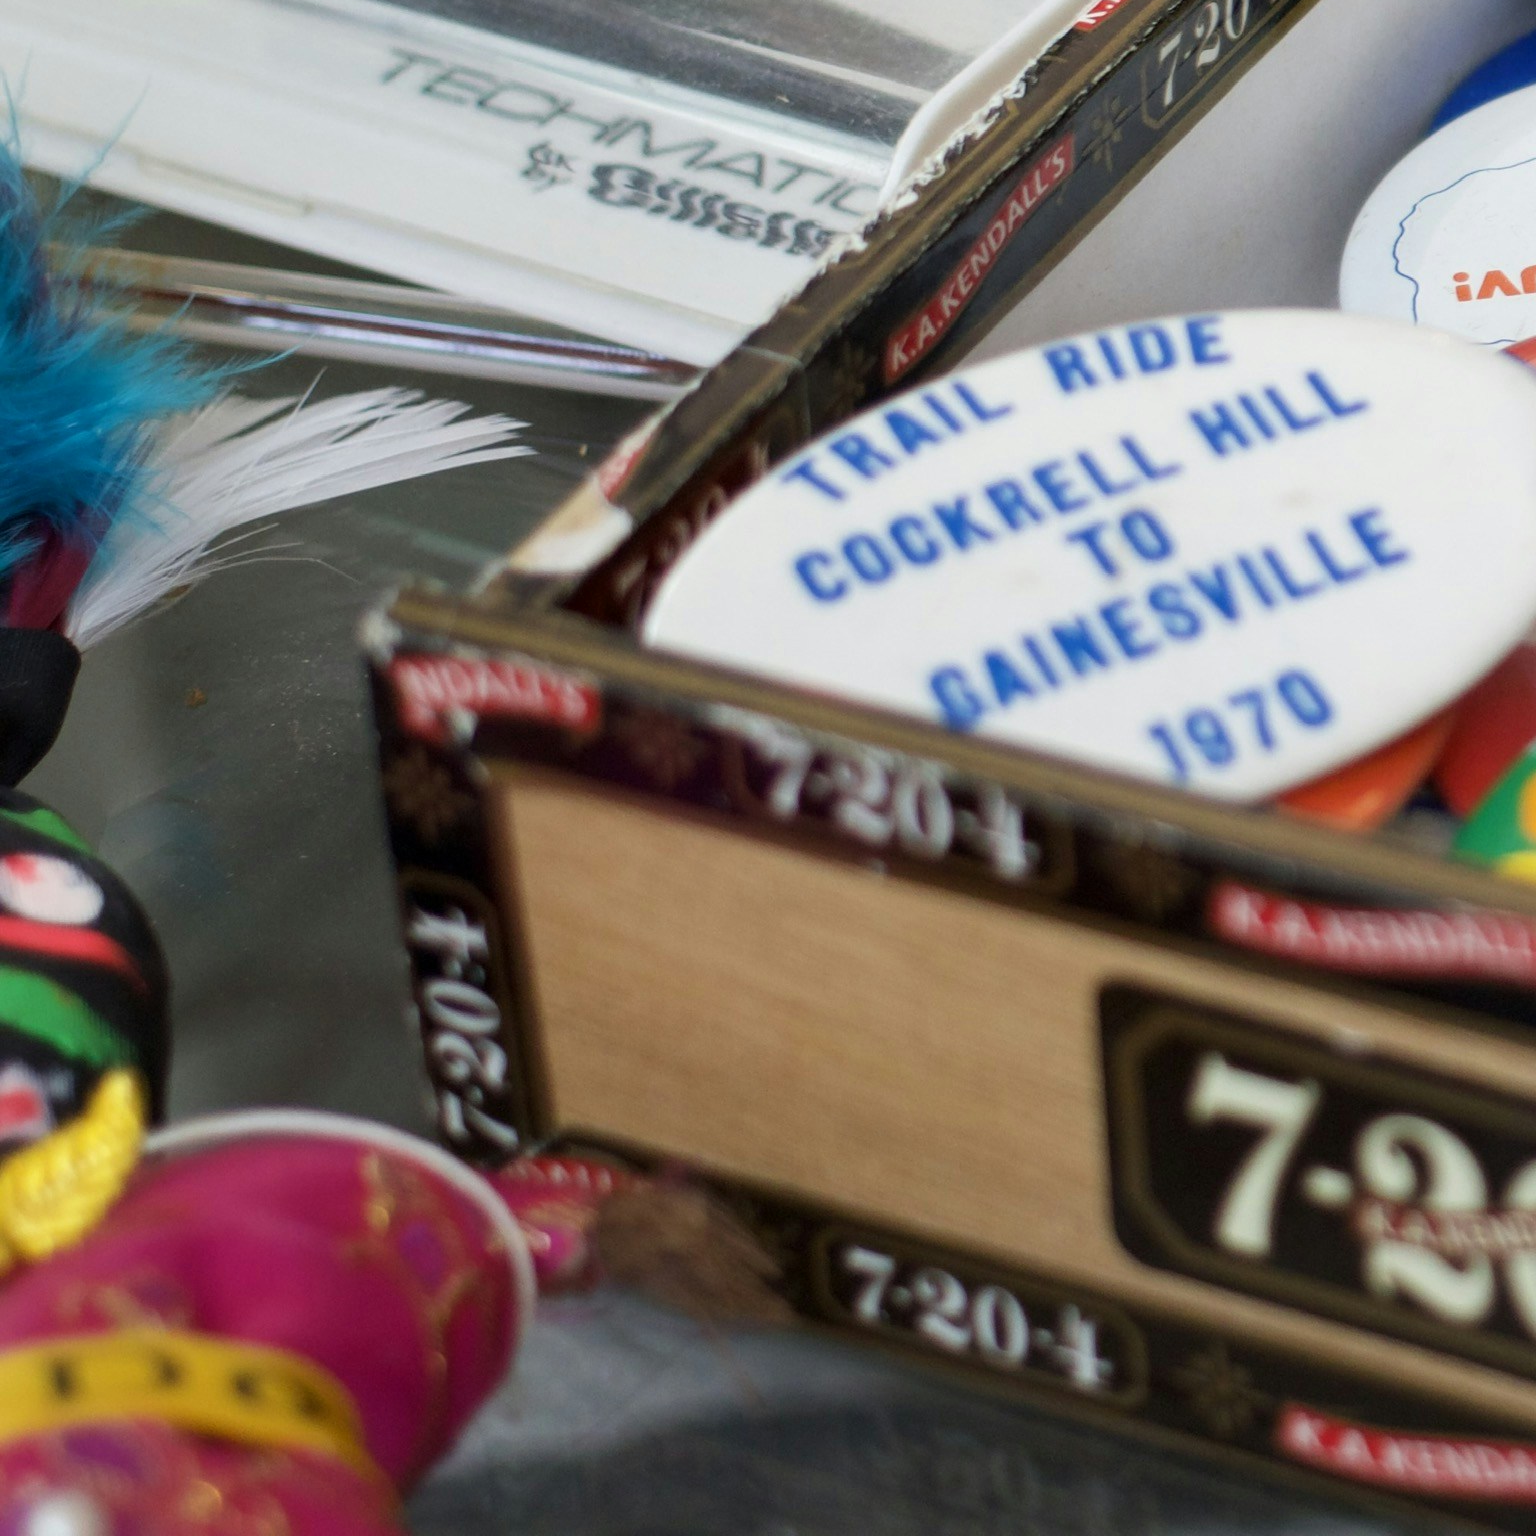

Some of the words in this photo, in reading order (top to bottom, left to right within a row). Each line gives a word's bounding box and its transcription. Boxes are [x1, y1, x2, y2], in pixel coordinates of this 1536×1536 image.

[380, 46, 882, 217] TECHMATIC
[778, 378, 1015, 506] TRAIL
[1042, 314, 1234, 396] RIDE
[792, 433, 1183, 607] COCKRELL
[1188, 368, 1371, 460] HILL
[925, 506, 1413, 736] GAINESVILLE
[1067, 508, 1178, 583] TO
[1147, 666, 1338, 789] 1970
[843, 1244, 1112, 1394] 7-20-4
